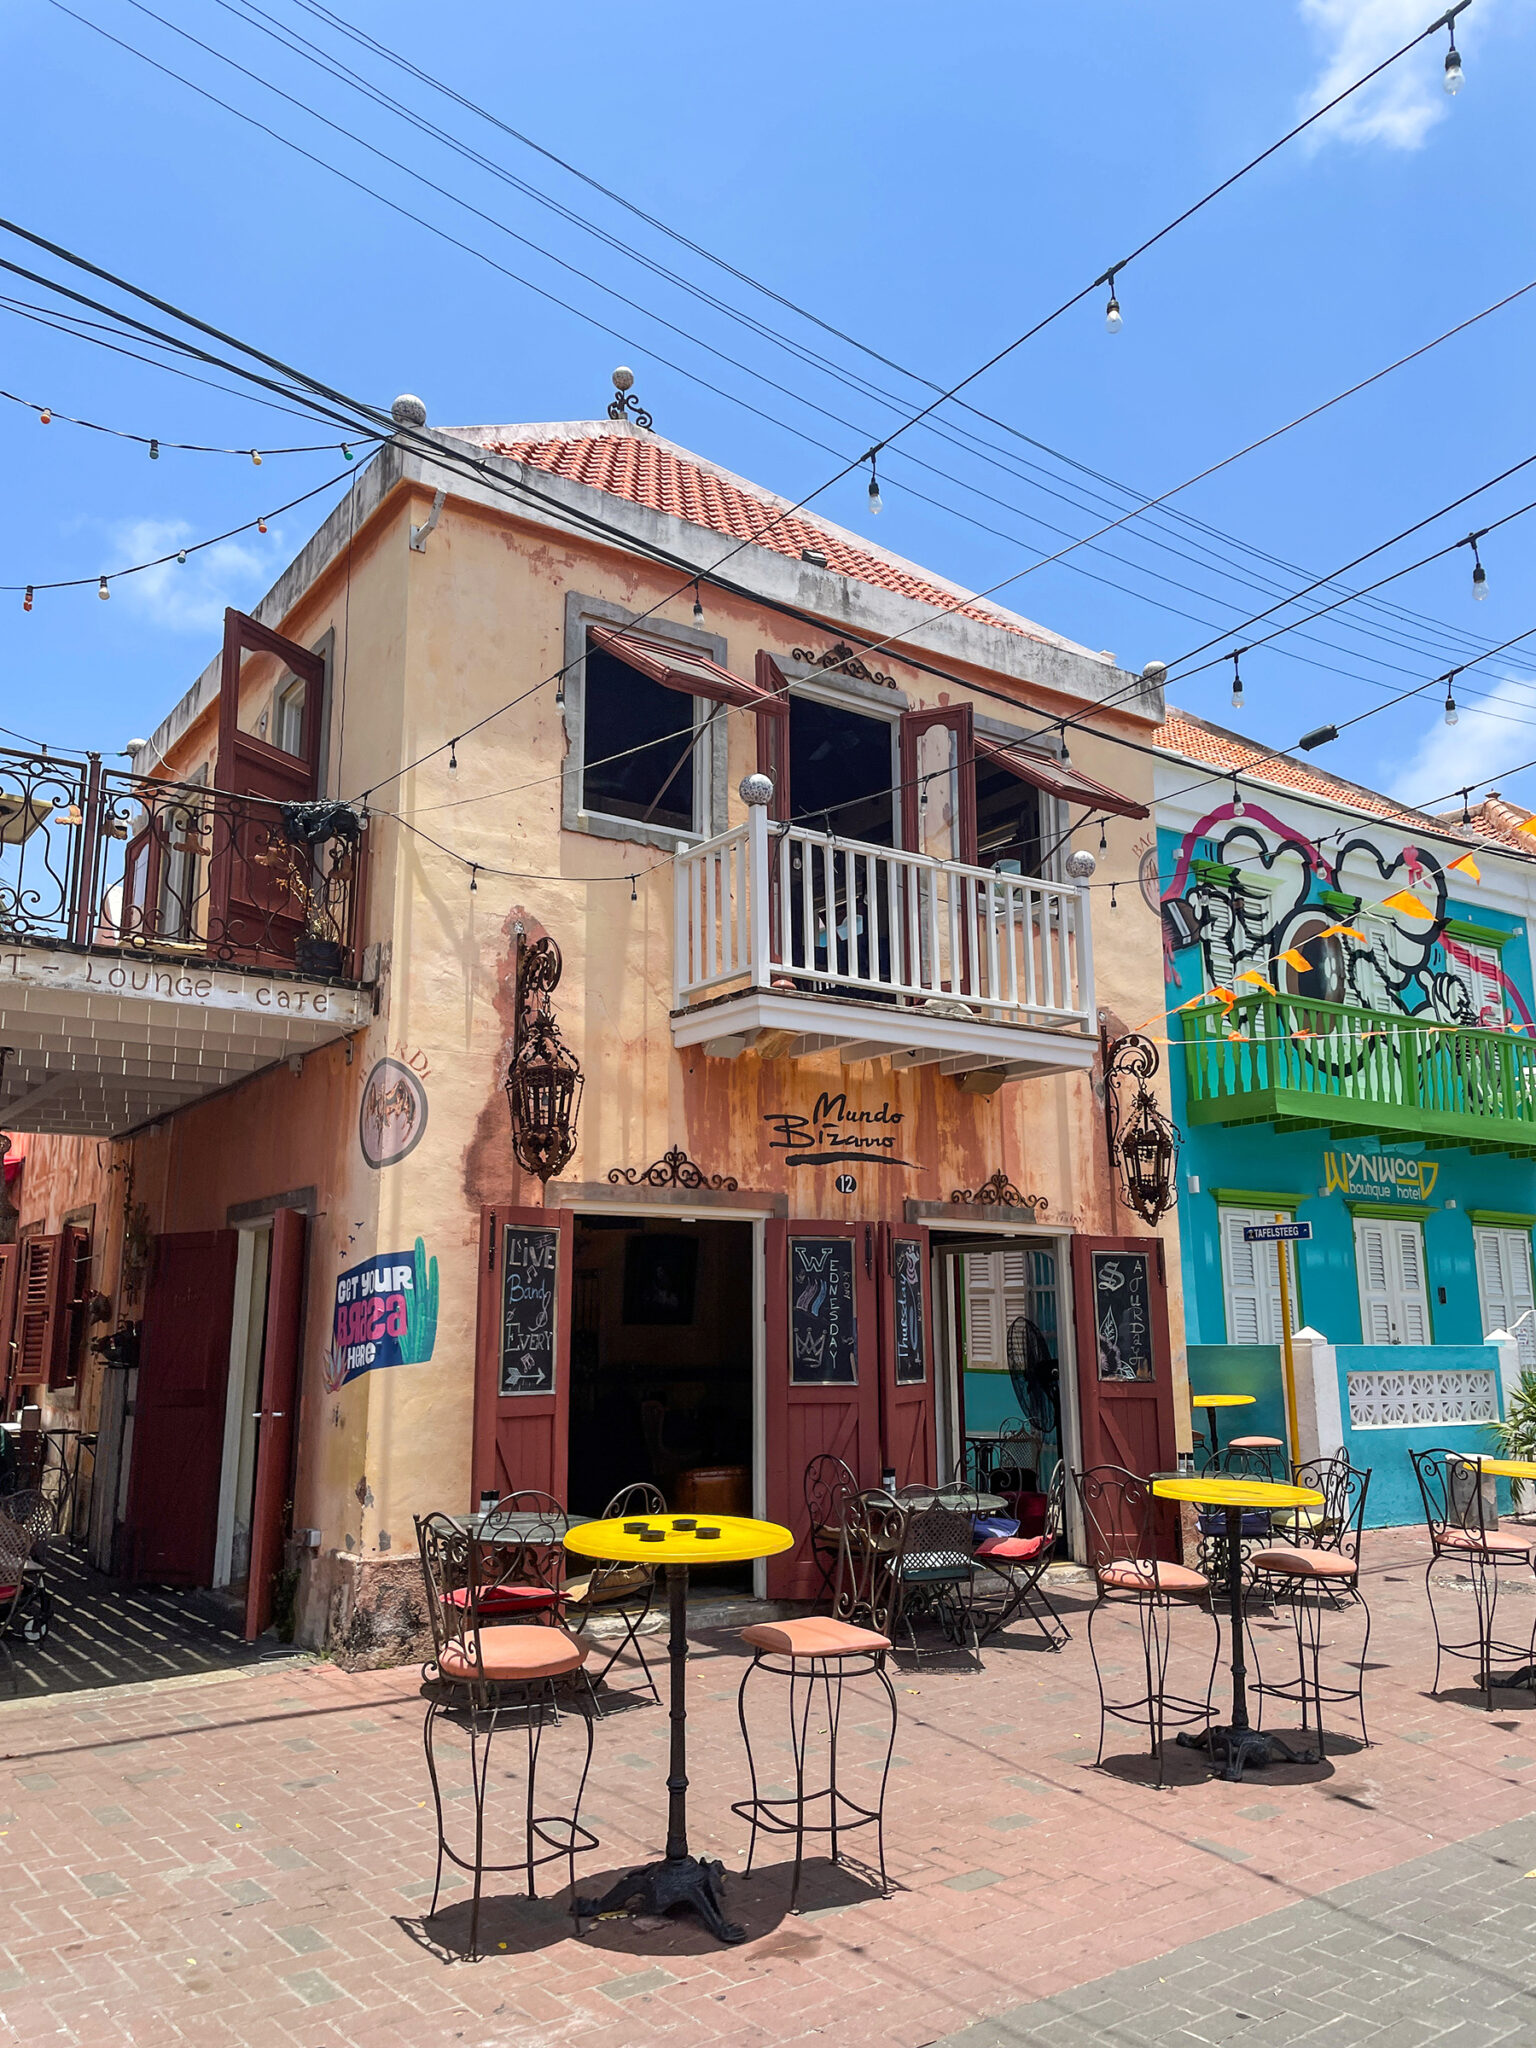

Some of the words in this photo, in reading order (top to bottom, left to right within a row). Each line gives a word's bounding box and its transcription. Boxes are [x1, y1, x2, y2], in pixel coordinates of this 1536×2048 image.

[813, 1091, 905, 1125] Mundo
[763, 1114, 896, 1149] Bizarro
[840, 1175, 853, 1193] 12
[1324, 1151, 1440, 1200] WYNWOOD
[1349, 1180, 1391, 1199] boutique
[1397, 1184, 1421, 1200] hotel
[1254, 1225, 1299, 1238] TAFELSTEEG
[509, 1237, 556, 1270] LiVE
[337, 1272, 359, 1304] GeT
[360, 1265, 414, 1297] YOUR
[507, 1273, 547, 1305] Band
[505, 1322, 553, 1353] EVERY
[347, 1341, 376, 1371] HeRe
